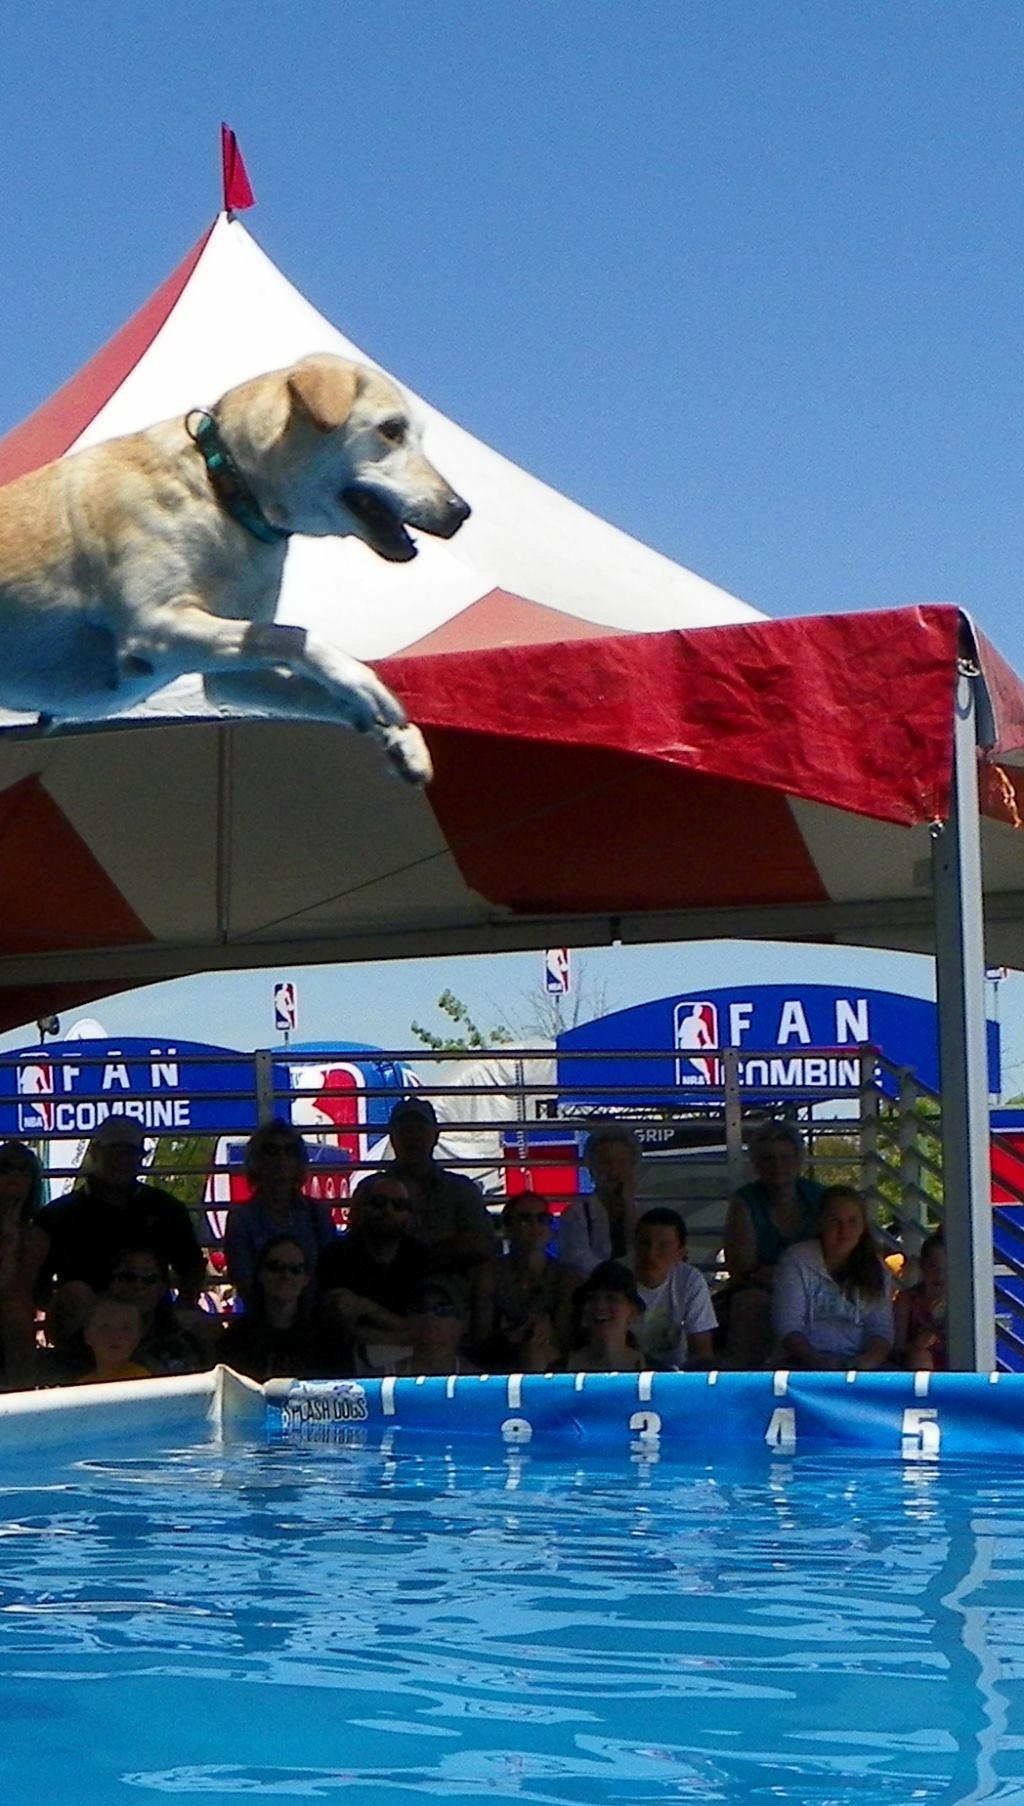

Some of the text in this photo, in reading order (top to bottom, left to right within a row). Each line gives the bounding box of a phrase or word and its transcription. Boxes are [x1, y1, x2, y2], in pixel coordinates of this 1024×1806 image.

[730, 999, 869, 1047] FAN
[62, 1048, 179, 1091] FAN
[56, 1100, 192, 1131] COMBINE
[333, 1397, 367, 1420] DOGS
[765, 1408, 796, 1452] 4
[902, 1408, 940, 1460] 5
